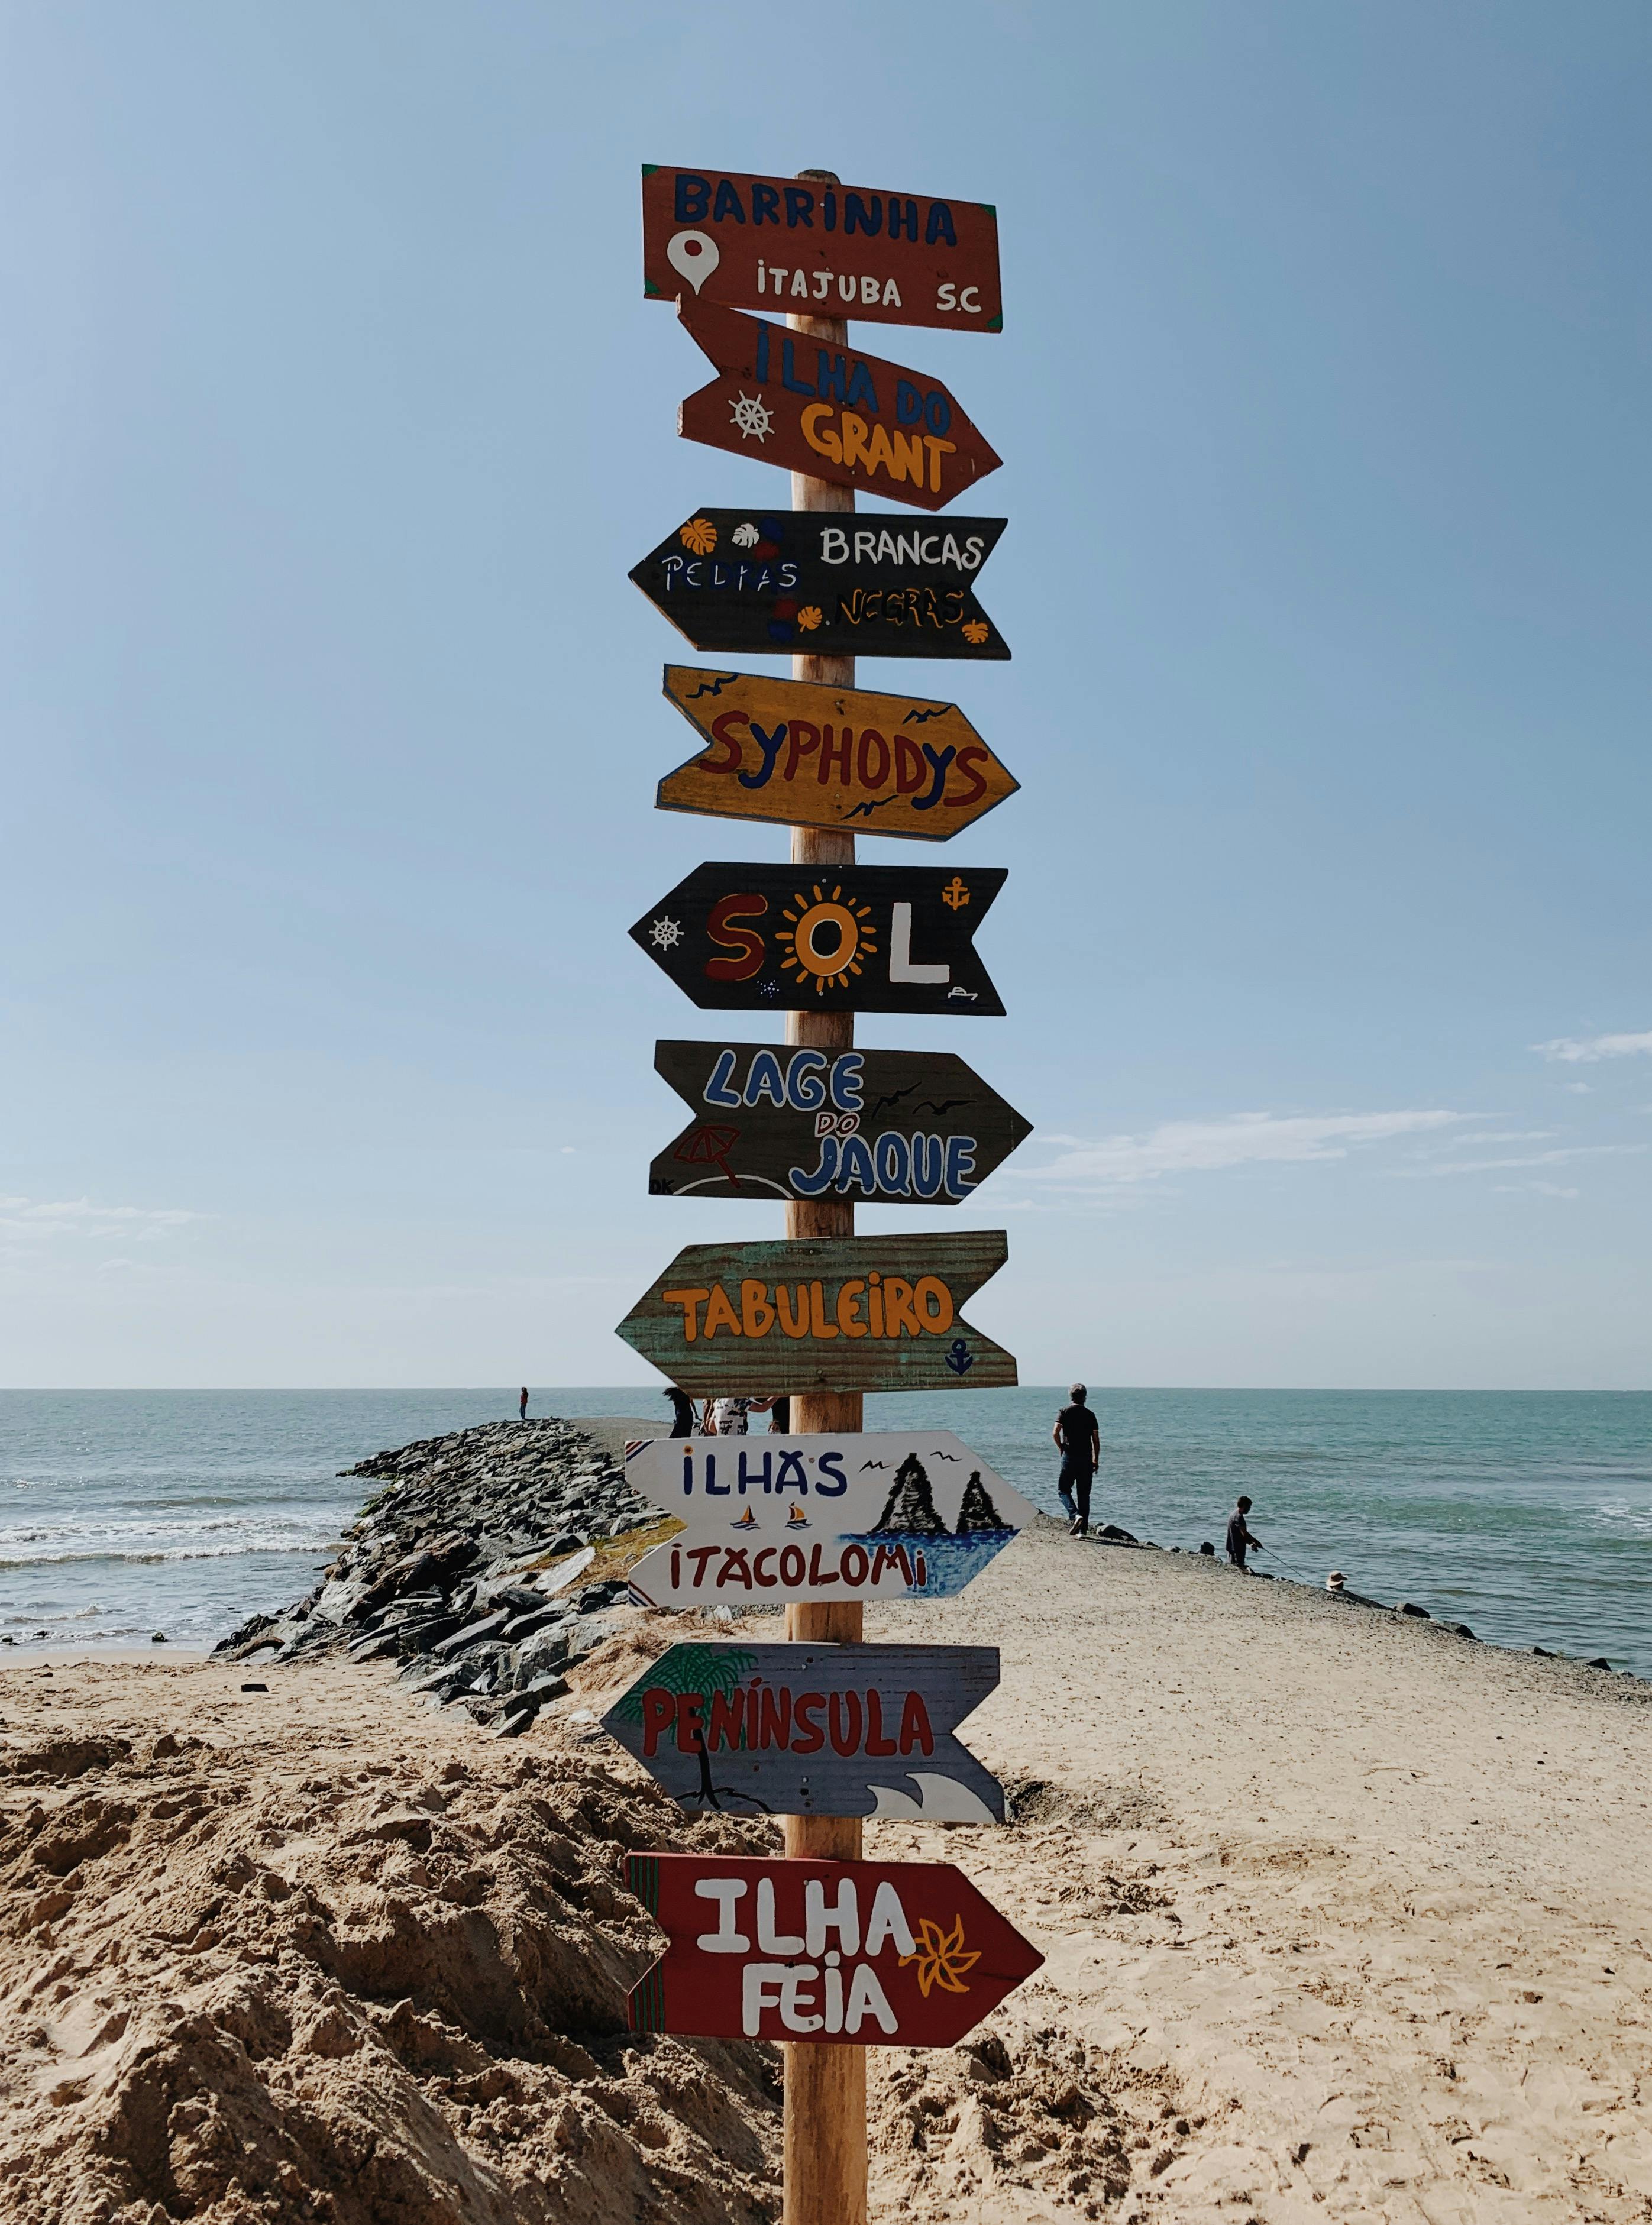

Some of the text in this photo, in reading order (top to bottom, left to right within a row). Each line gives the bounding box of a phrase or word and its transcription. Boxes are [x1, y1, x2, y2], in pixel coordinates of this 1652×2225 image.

[674, 174, 957, 247] BARRINHA
[757, 259, 902, 308] ITAJUBA
[756, 319, 951, 436] ILHA DO
[800, 403, 956, 493] GRANT
[820, 528, 985, 571] BRANCAS
[835, 588, 965, 629] NEGRAS
[697, 710, 988, 811] SYPHODYS
[704, 893, 950, 984] SOL
[703, 1049, 865, 1111] LAGE
[814, 1112, 860, 1137] DO
[788, 1131, 978, 1199] JAQUE
[661, 1270, 955, 1343] TABULEIRO
[641, 1676, 935, 1758] PENÍNSULA
[694, 1877, 917, 1959] ILHA
[742, 1950, 899, 2037] FEIA
